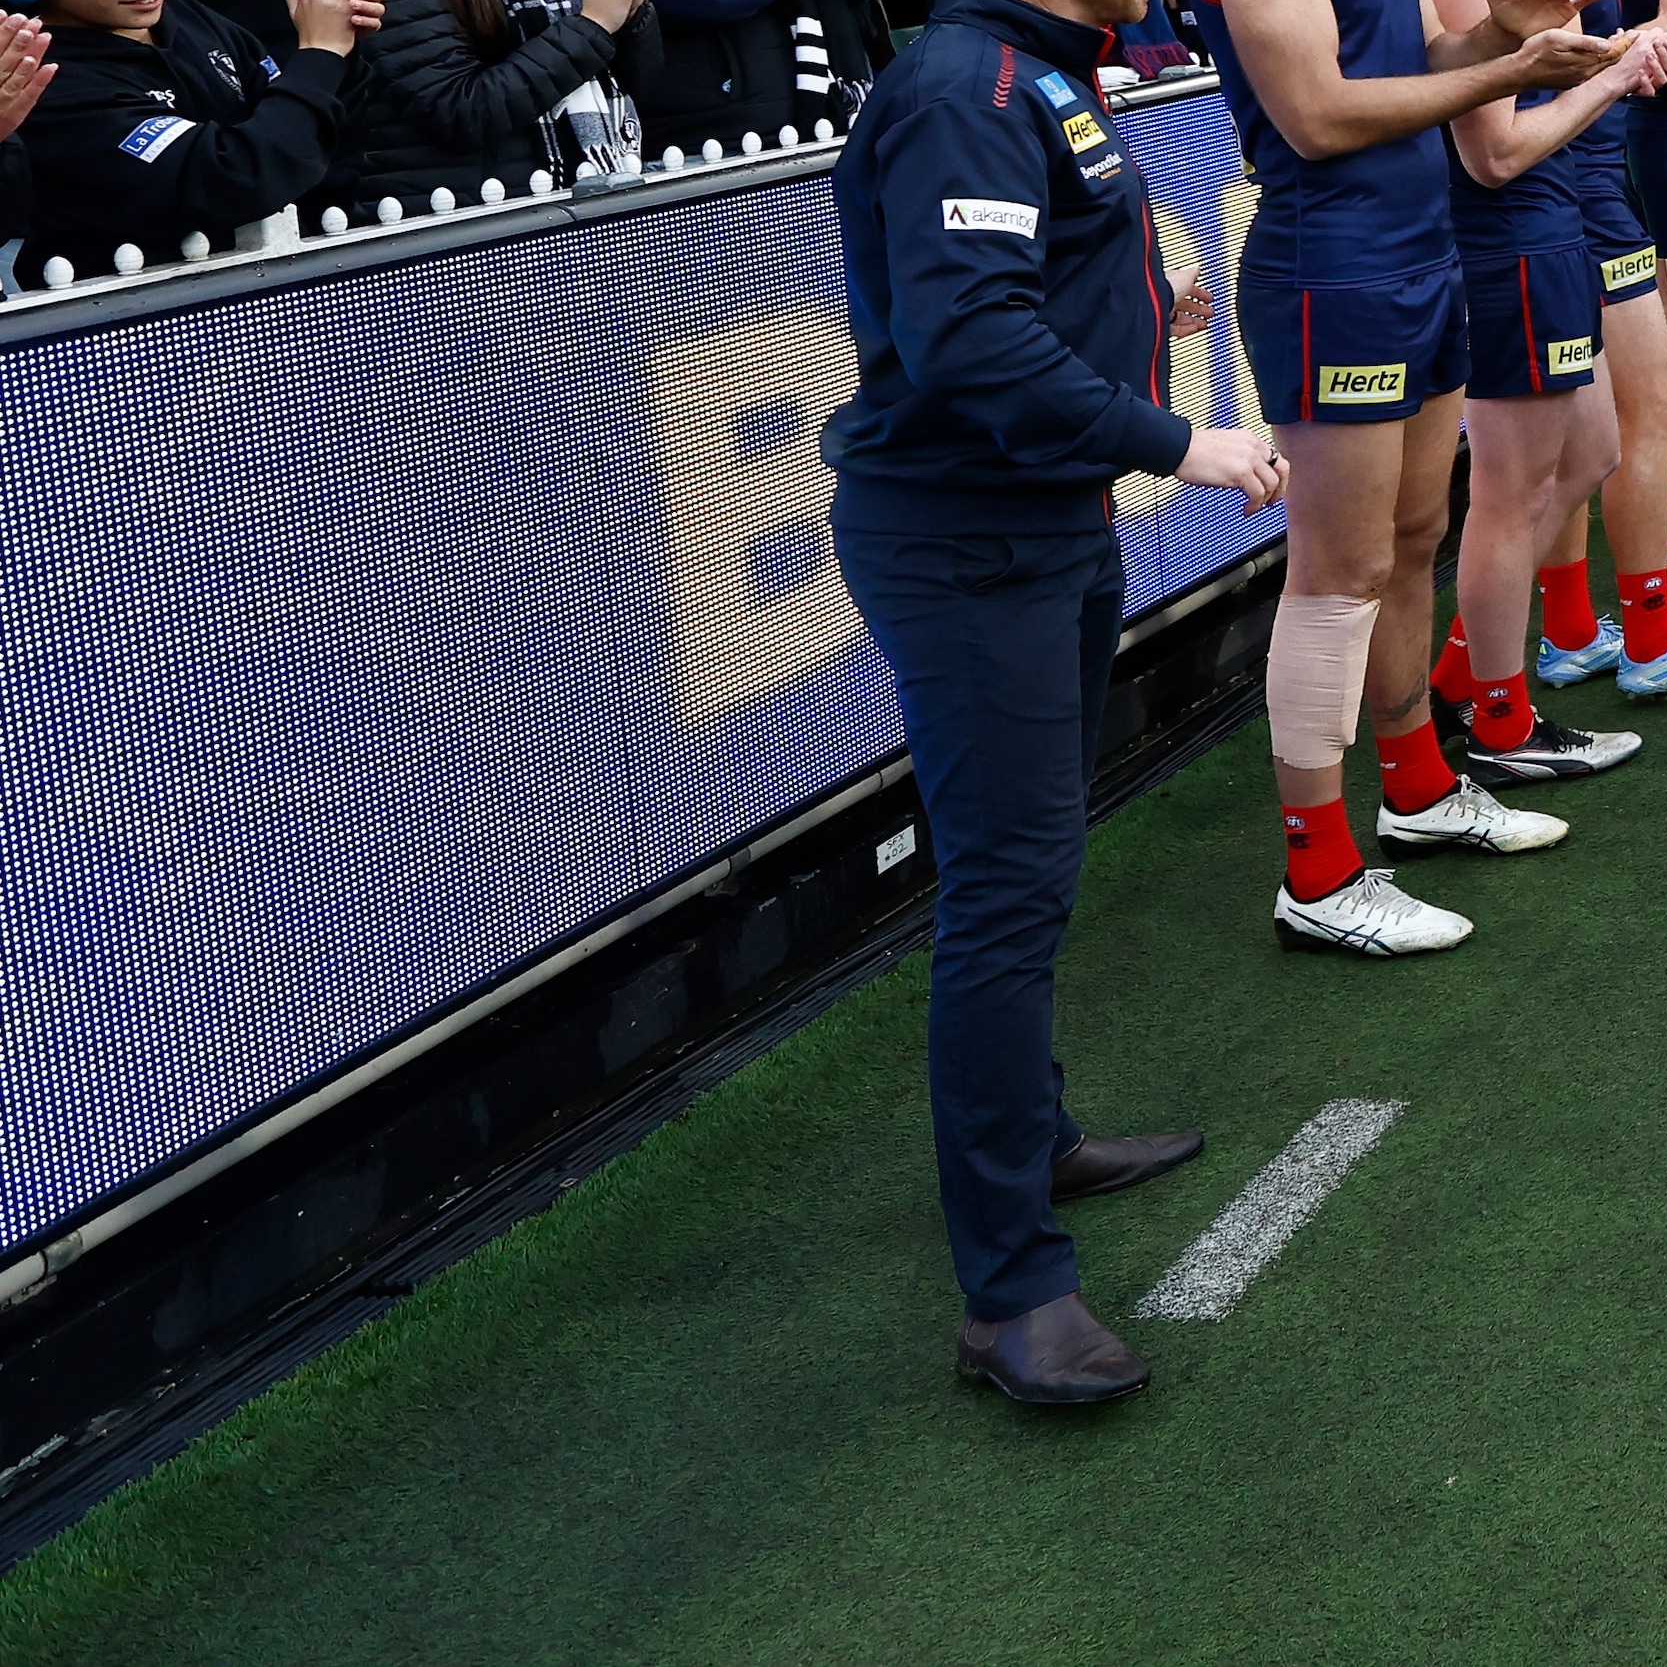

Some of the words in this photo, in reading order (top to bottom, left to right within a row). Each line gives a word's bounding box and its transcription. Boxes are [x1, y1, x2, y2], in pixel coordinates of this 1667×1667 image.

[972, 206, 1036, 233] akambo
[1611, 253, 1655, 280] Hertz
[1330, 370, 1401, 394] Hertz
